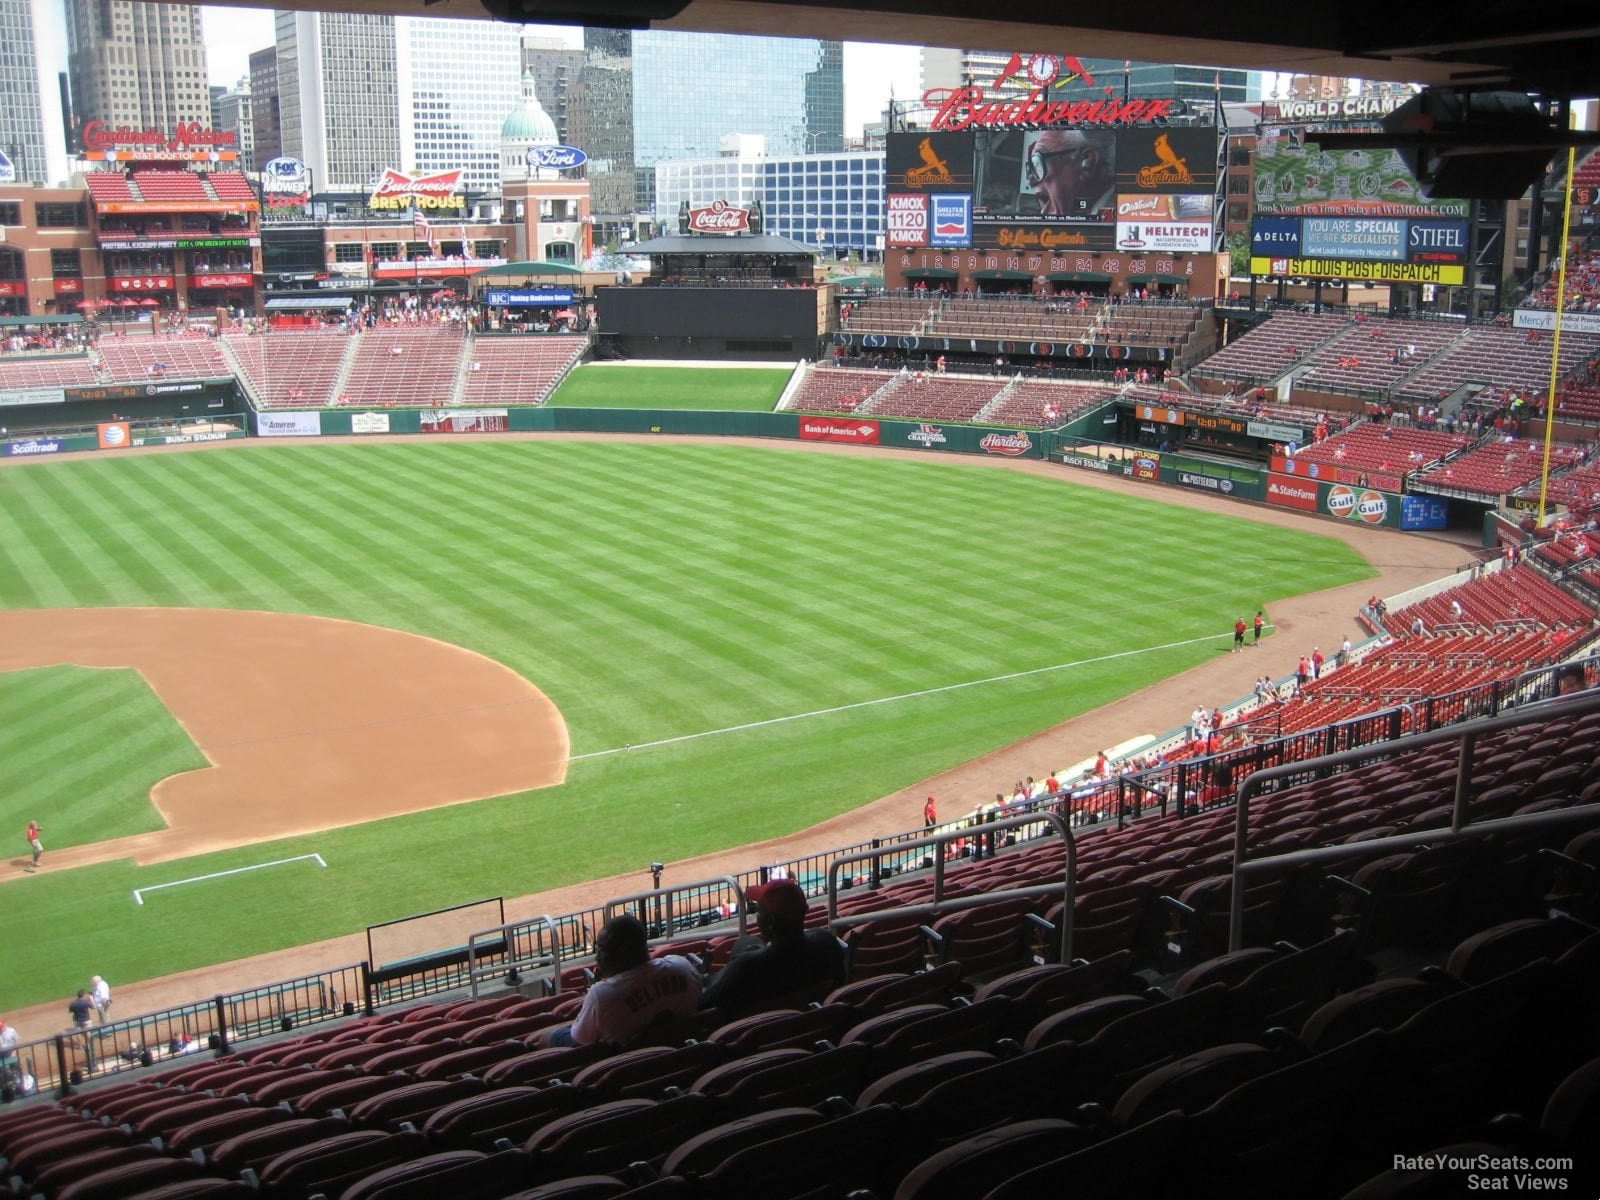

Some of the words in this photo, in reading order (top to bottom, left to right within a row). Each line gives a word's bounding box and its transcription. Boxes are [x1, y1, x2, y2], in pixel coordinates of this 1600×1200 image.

[922, 86, 1175, 131] Budweiser
[1280, 101, 1338, 117] WORLD
[83, 120, 166, 149] Cardinals
[167, 121, 236, 150] Nation
[133, 152, 153, 160] AT&T
[153, 152, 195, 160] ROOFTOP
[540, 148, 576, 165] Ford
[275, 163, 297, 172] FOX
[904, 166, 955, 188] Cardinals
[1135, 167, 1194, 188] Cardinals
[263, 182, 311, 192] MIDWEST
[380, 177, 460, 194] Budweiser
[370, 196, 411, 208] BREW
[416, 195, 465, 208] HOUSE
[890, 198, 924, 209] KMOX
[1257, 204, 1277, 213] Book
[1279, 204, 1299, 213] Your
[1303, 204, 1319, 213] Tee
[1320, 204, 1340, 213] Time
[1343, 205, 1367, 215] Today
[890, 213, 924, 227] 1120
[1145, 227, 1208, 237] HELITECH
[1309, 220, 1329, 232] YOU
[1331, 221, 1351, 232] ARE
[1354, 221, 1400, 233] SPECIAL
[890, 230, 924, 242] KMOX
[1264, 232, 1297, 241] DELTA
[1308, 233, 1320, 242] WE
[1322, 233, 1338, 243] ARE
[1341, 234, 1400, 245] SPECIALISTS
[1409, 225, 1464, 247] STIFEL
[1337, 247, 1365, 256] University
[1366, 248, 1391, 257] Hospital
[921, 255, 927, 268] 1
[934, 256, 942, 268] 2
[951, 256, 959, 268] 6
[968, 256, 976, 269] 9
[985, 256, 998, 269] 10
[1006, 257, 1019, 270] 14
[1028, 257, 1041, 270] 17
[1050, 258, 1067, 271] 20
[1076, 259, 1092, 272] 24
[1102, 259, 1119, 273] 42
[1128, 260, 1146, 273] 45
[1155, 260, 1173, 274] 85
[1292, 260, 1307, 274] ST.
[1309, 260, 1342, 276] LOUIS
[1346, 262, 1440, 281] POST-DISPATCH
[491, 294, 507, 304] BJC
[1519, 315, 1545, 327] Mercy
[269, 421, 296, 429] Ameren
[1198, 418, 1216, 428] 12:03
[805, 424, 821, 433] Bank
[829, 426, 857, 436] America
[165, 435, 192, 443] BUSCH
[193, 432, 226, 441] STADIUM
[907, 434, 946, 443] CHAMPIONS
[12, 441, 59, 454] Scottrade
[1063, 455, 1082, 465] BUSCH
[1083, 459, 1108, 470] STADIUM
[1279, 485, 1297, 497] State
[1297, 489, 1315, 500] Farm
[1329, 496, 1354, 507] Gulf
[1359, 502, 1384, 513] Gulf
